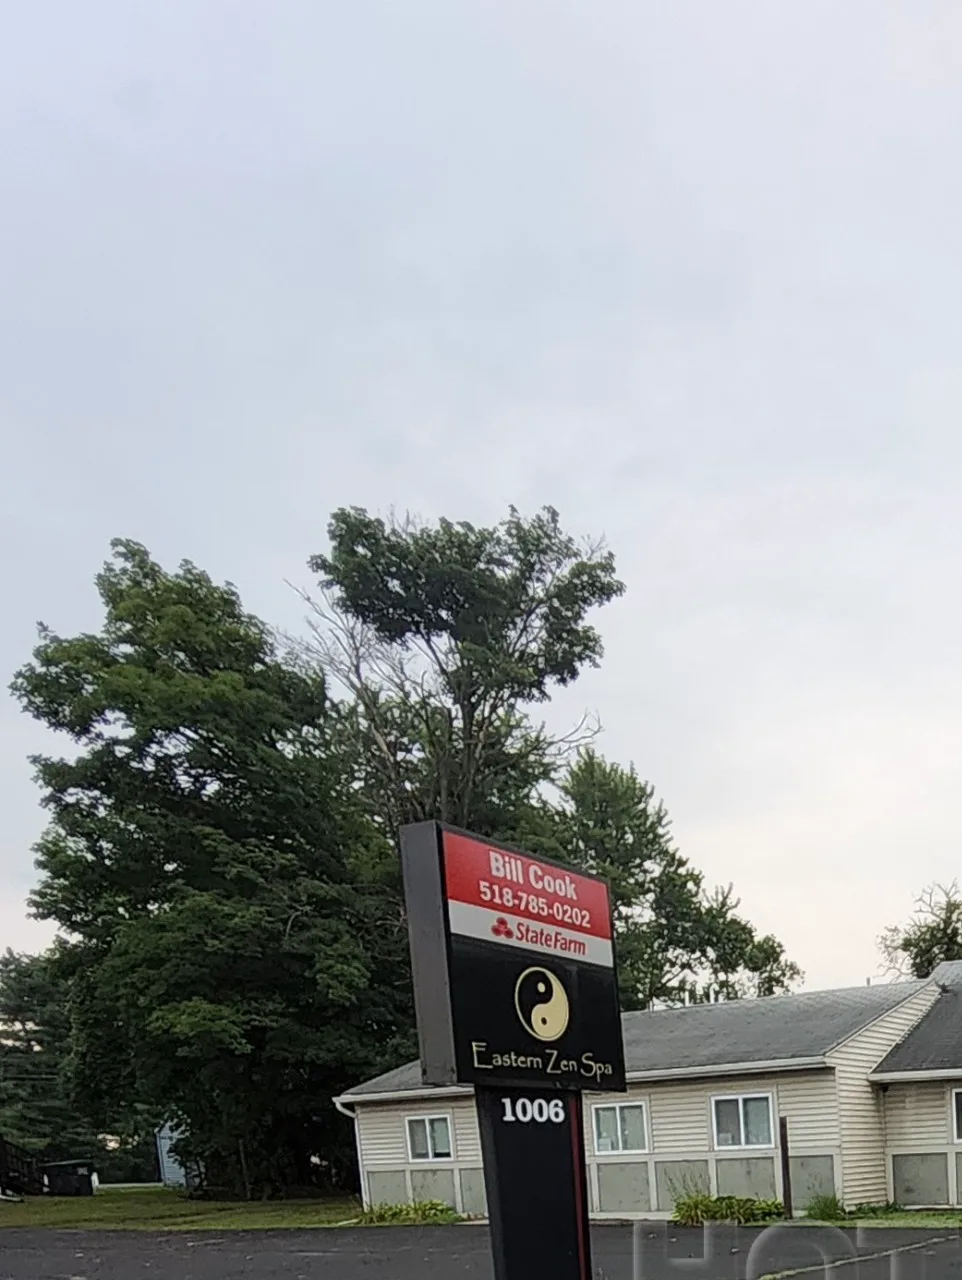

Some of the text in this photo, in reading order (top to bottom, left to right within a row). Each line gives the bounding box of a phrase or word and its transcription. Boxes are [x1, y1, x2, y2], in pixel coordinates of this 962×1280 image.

[489, 850, 577, 900] Bill Cook
[479, 880, 591, 928] 518-785-0202
[472, 1041, 613, 1083] Eastern Zen Spa
[501, 1097, 566, 1123] 1006
